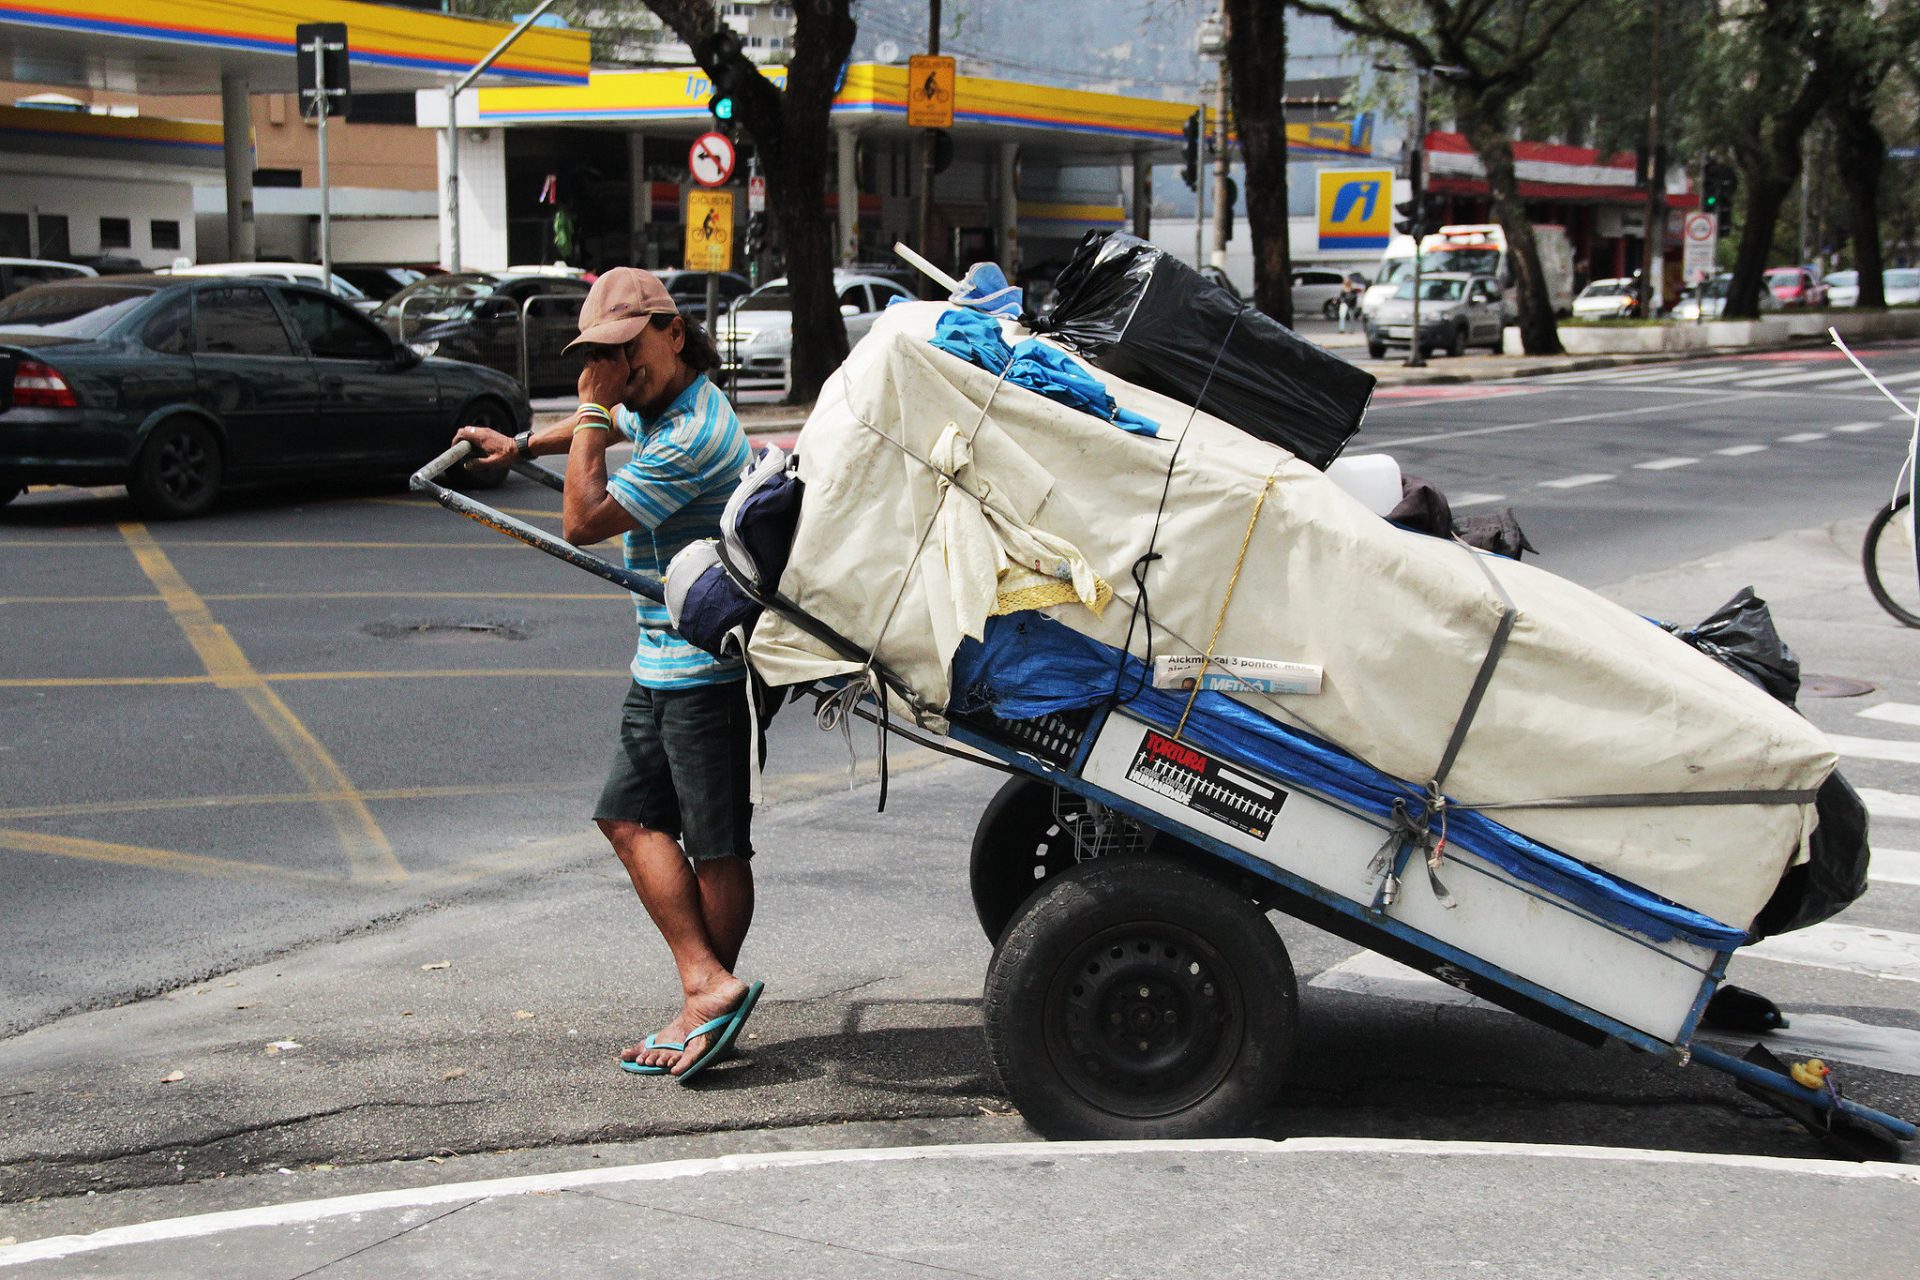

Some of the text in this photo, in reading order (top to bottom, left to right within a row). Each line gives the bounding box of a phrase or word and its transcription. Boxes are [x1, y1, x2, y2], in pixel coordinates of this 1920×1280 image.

[1231, 657, 1239, 666] 3
[1146, 733, 1207, 774] TORTURA
[1128, 769, 1193, 806] HUMANIDADE
[1140, 765, 1161, 780] CRIME
[1161, 775, 1189, 794] CONTRA
